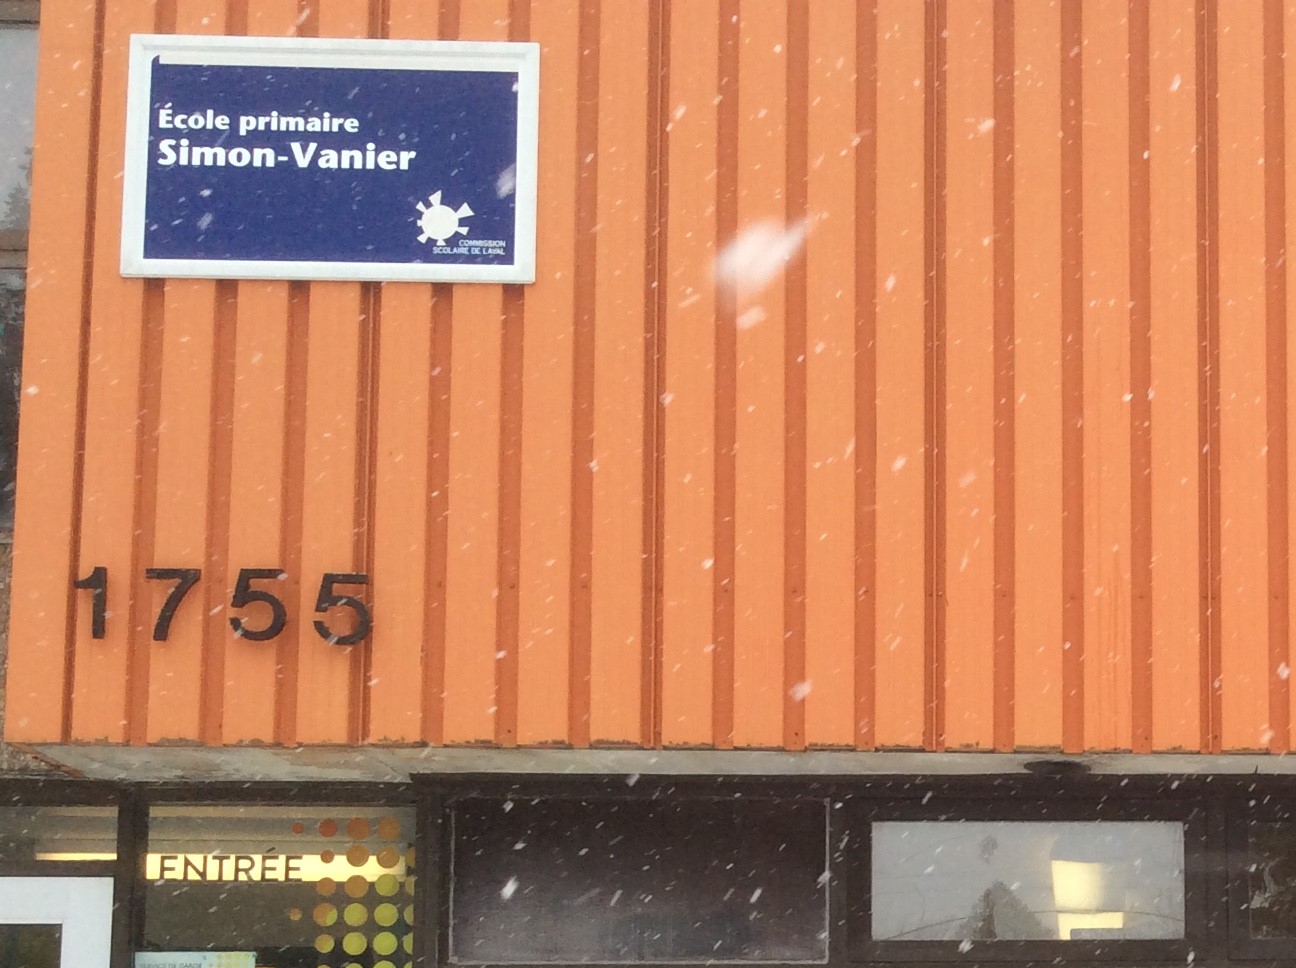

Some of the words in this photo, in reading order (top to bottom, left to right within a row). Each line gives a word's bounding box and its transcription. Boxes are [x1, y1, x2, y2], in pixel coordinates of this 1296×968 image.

[158, 103, 230, 131] École
[239, 110, 360, 136] primaire
[157, 138, 417, 171] Simon-Vanier
[432, 246, 470, 255] SCOLAIRE
[470, 246, 482, 255] DE
[458, 239, 507, 248] COMMISSION
[74, 566, 373, 646] 1755
[159, 846, 303, 883] ENTRÉE
